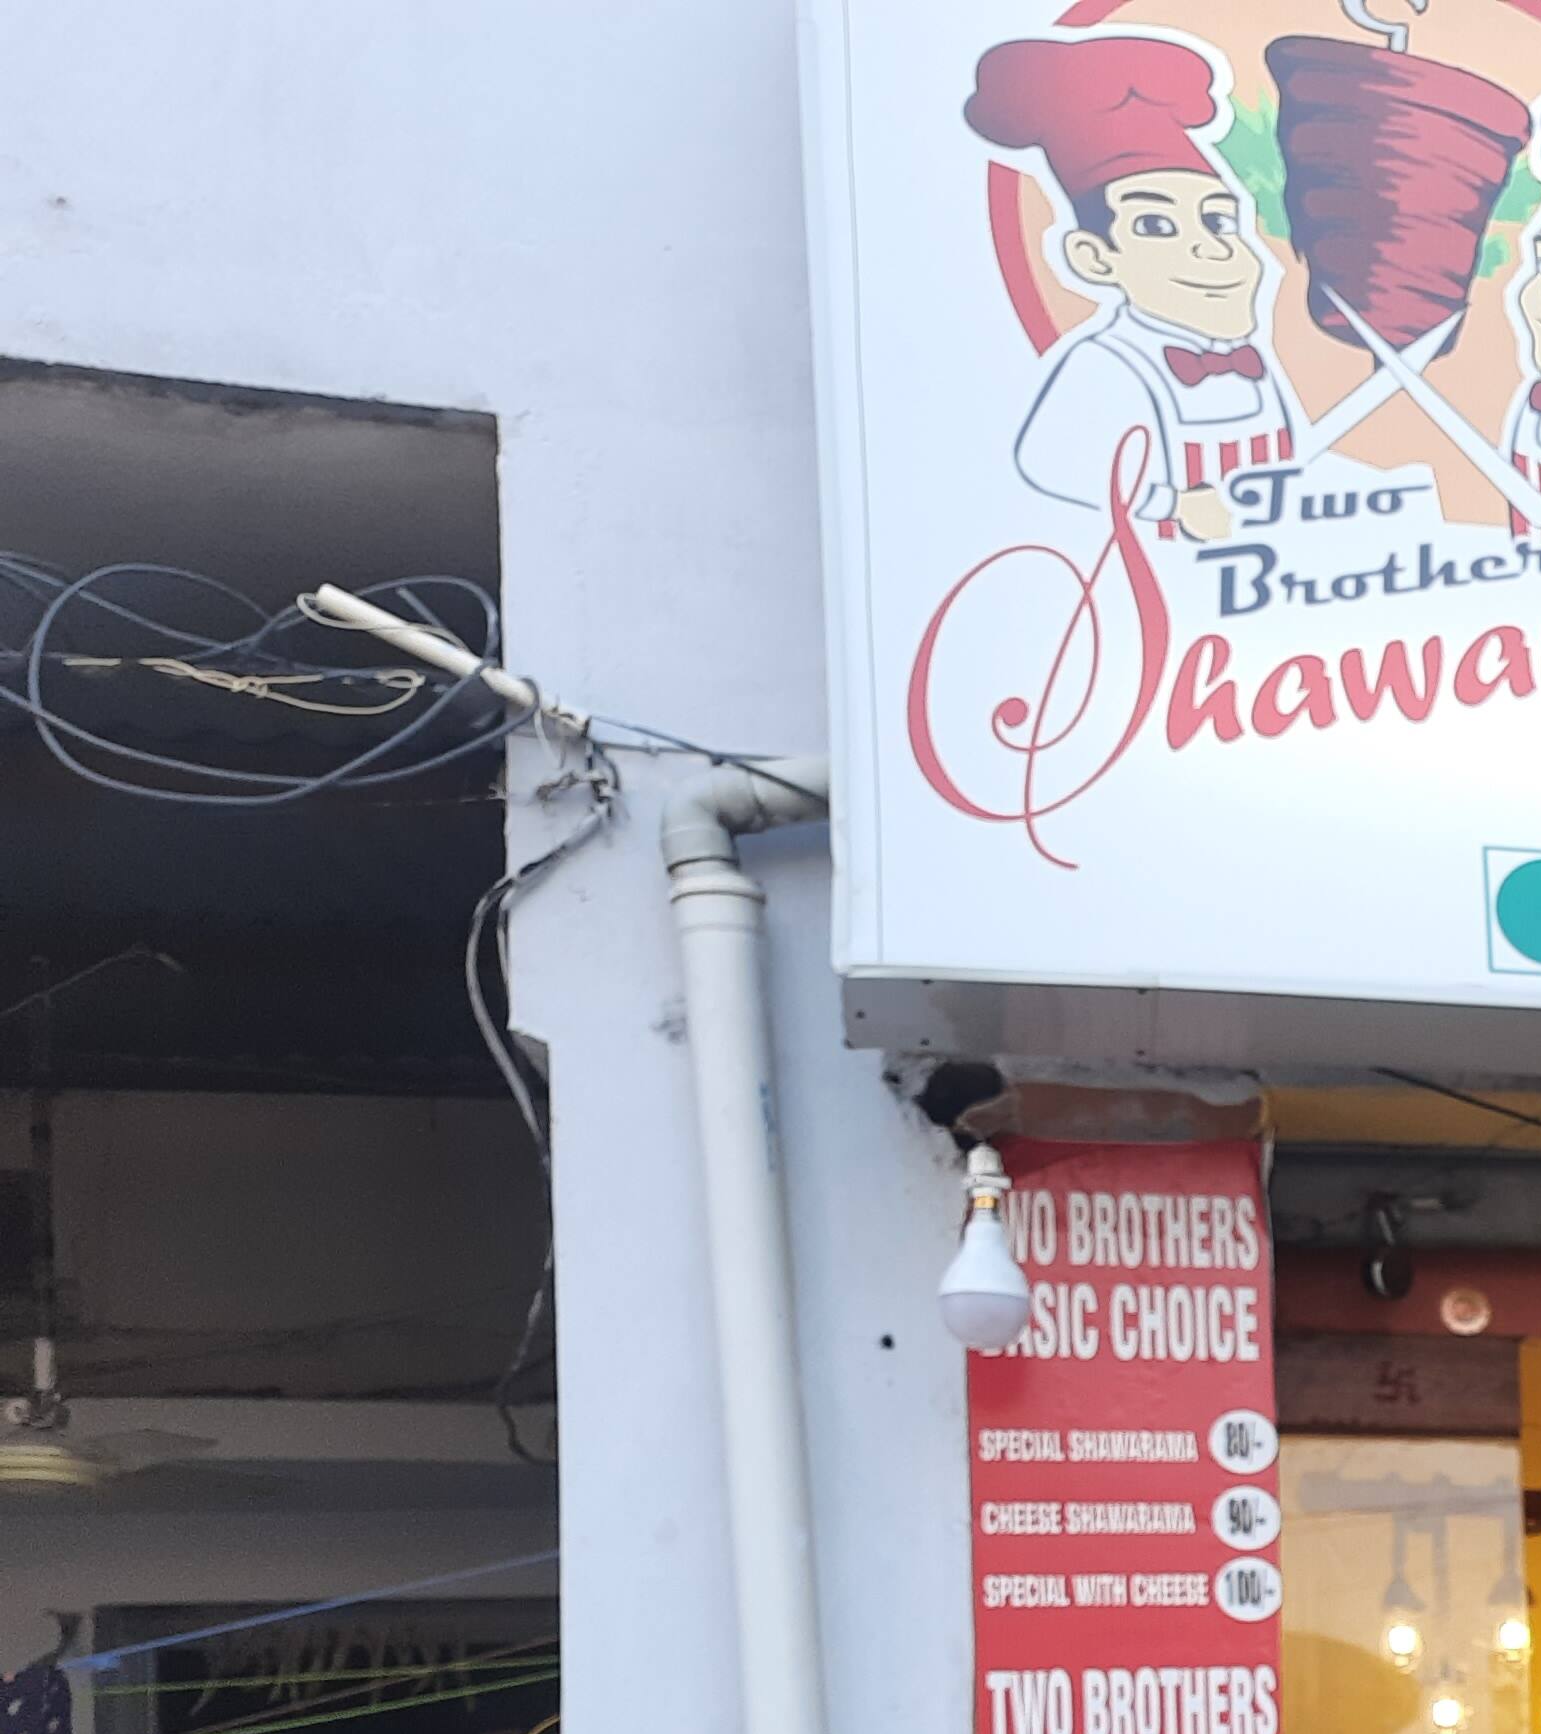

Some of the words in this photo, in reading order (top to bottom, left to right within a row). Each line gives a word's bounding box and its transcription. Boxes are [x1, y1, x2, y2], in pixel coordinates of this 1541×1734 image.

[1229, 465, 1433, 528] Two
[1002, 1190, 1056, 1265] WO
[1067, 1191, 1259, 1270] BROTHERS
[1110, 1282, 1260, 1362] CHOICE
[979, 1427, 1066, 1463] SPECIAL
[980, 1501, 1063, 1535] CHEESE
[982, 1573, 1071, 1608] SPECIAL
[1071, 1573, 1129, 1607] WITH
[1130, 1573, 1210, 1607] CHEESE
